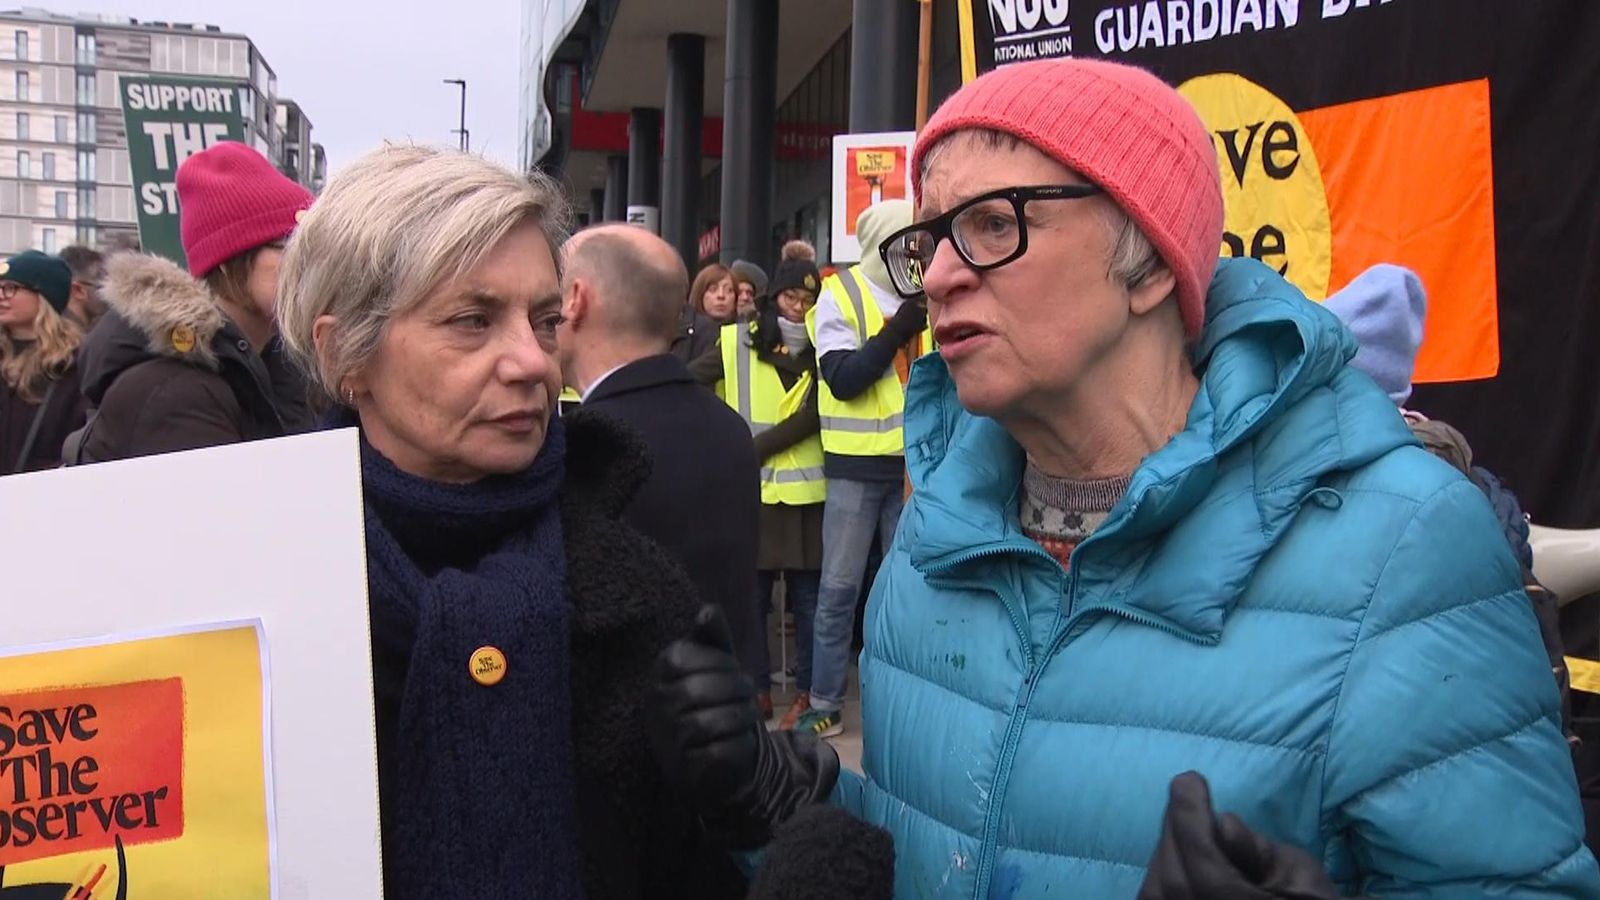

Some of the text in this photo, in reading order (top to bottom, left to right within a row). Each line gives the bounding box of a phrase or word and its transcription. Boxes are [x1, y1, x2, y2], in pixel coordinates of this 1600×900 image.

[1038, 35, 1072, 57] UNION
[1094, 0, 1300, 54] GUARDIAN
[127, 83, 233, 113] SUPPORT
[1208, 120, 1301, 190] ve
[0, 703, 99, 757] Save
[0, 747, 99, 805] The
